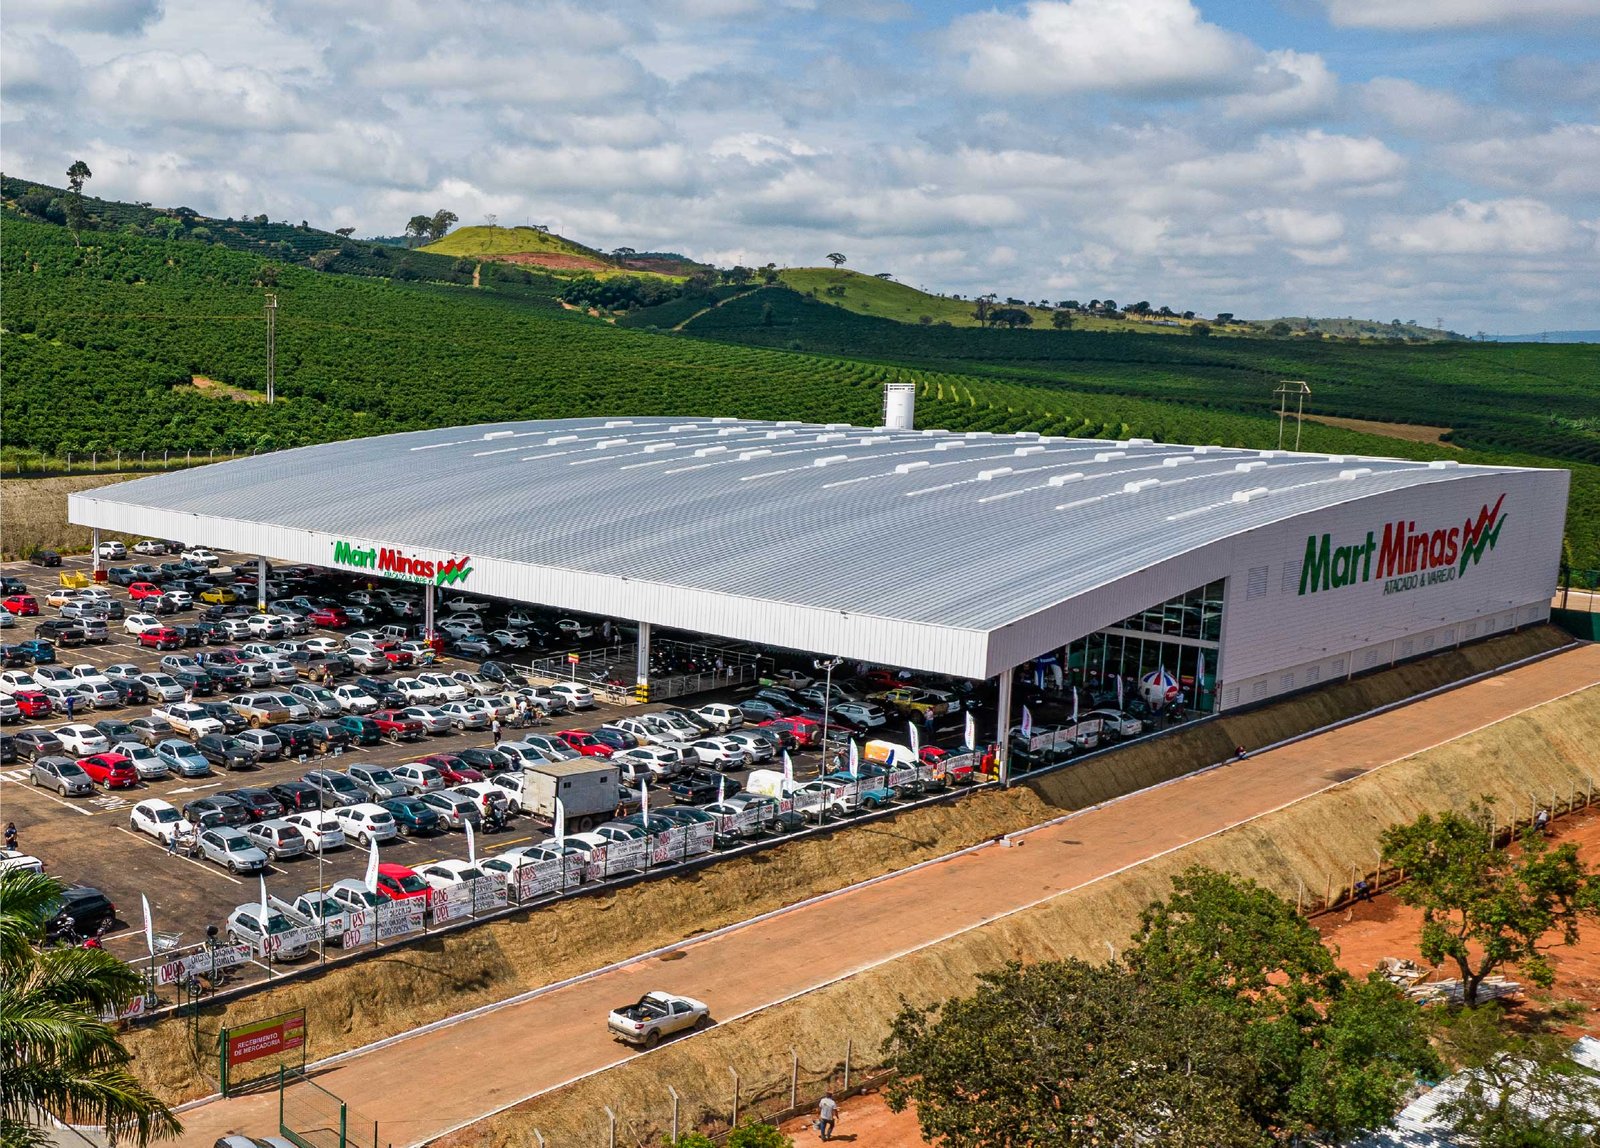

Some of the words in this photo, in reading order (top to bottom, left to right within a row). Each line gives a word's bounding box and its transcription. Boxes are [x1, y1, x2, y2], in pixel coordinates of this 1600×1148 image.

[334, 540, 377, 570] Mart
[378, 547, 435, 578] Minas
[1298, 531, 1376, 595] Mart
[1376, 520, 1460, 579] Minas
[1383, 574, 1418, 596] ATACADO
[1420, 573, 1425, 587] &
[1428, 567, 1456, 585] VAREJO
[234, 1049, 242, 1057] DE
[243, 1038, 281, 1055] MERCADORIA
[237, 1032, 278, 1049] RECEBIMENTO
